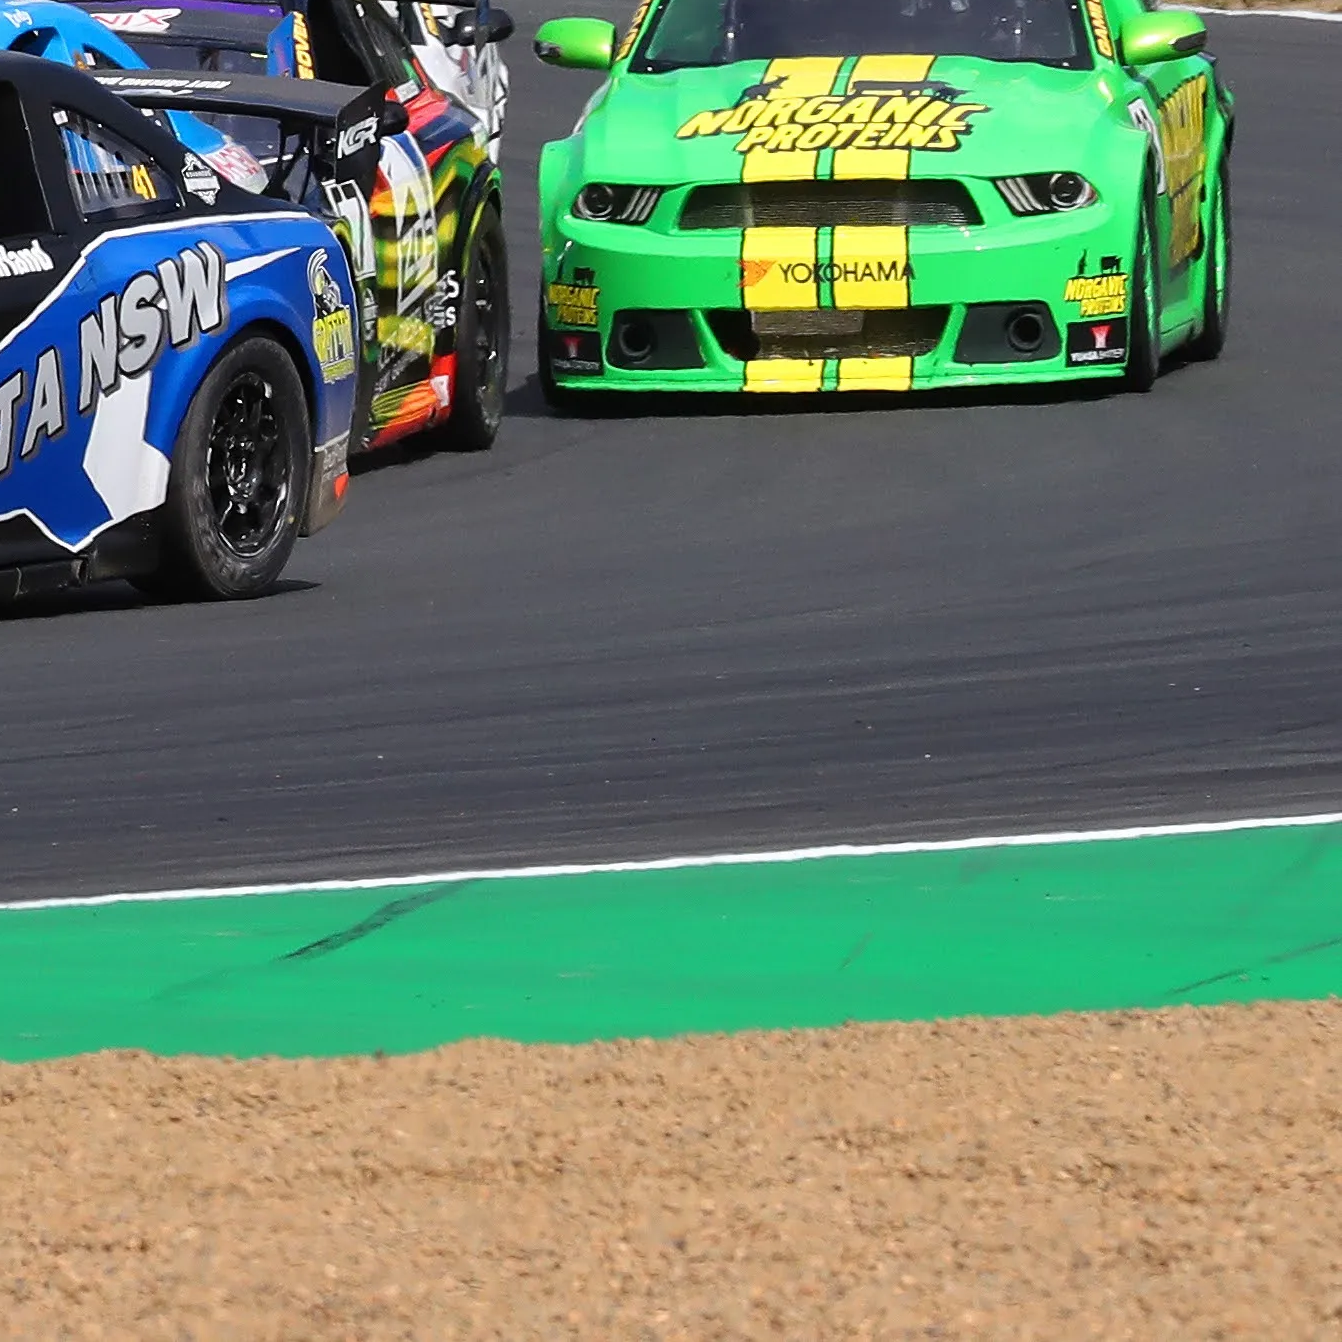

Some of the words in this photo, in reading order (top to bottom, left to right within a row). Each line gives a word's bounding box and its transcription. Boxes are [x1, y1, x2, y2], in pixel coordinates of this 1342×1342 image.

[675, 95, 992, 139] NORGANIC
[735, 121, 968, 152] PROTEINS
[131, 164, 157, 200] 41
[778, 260, 916, 284] YOKOHAMA
[78, 240, 226, 414] NSW
